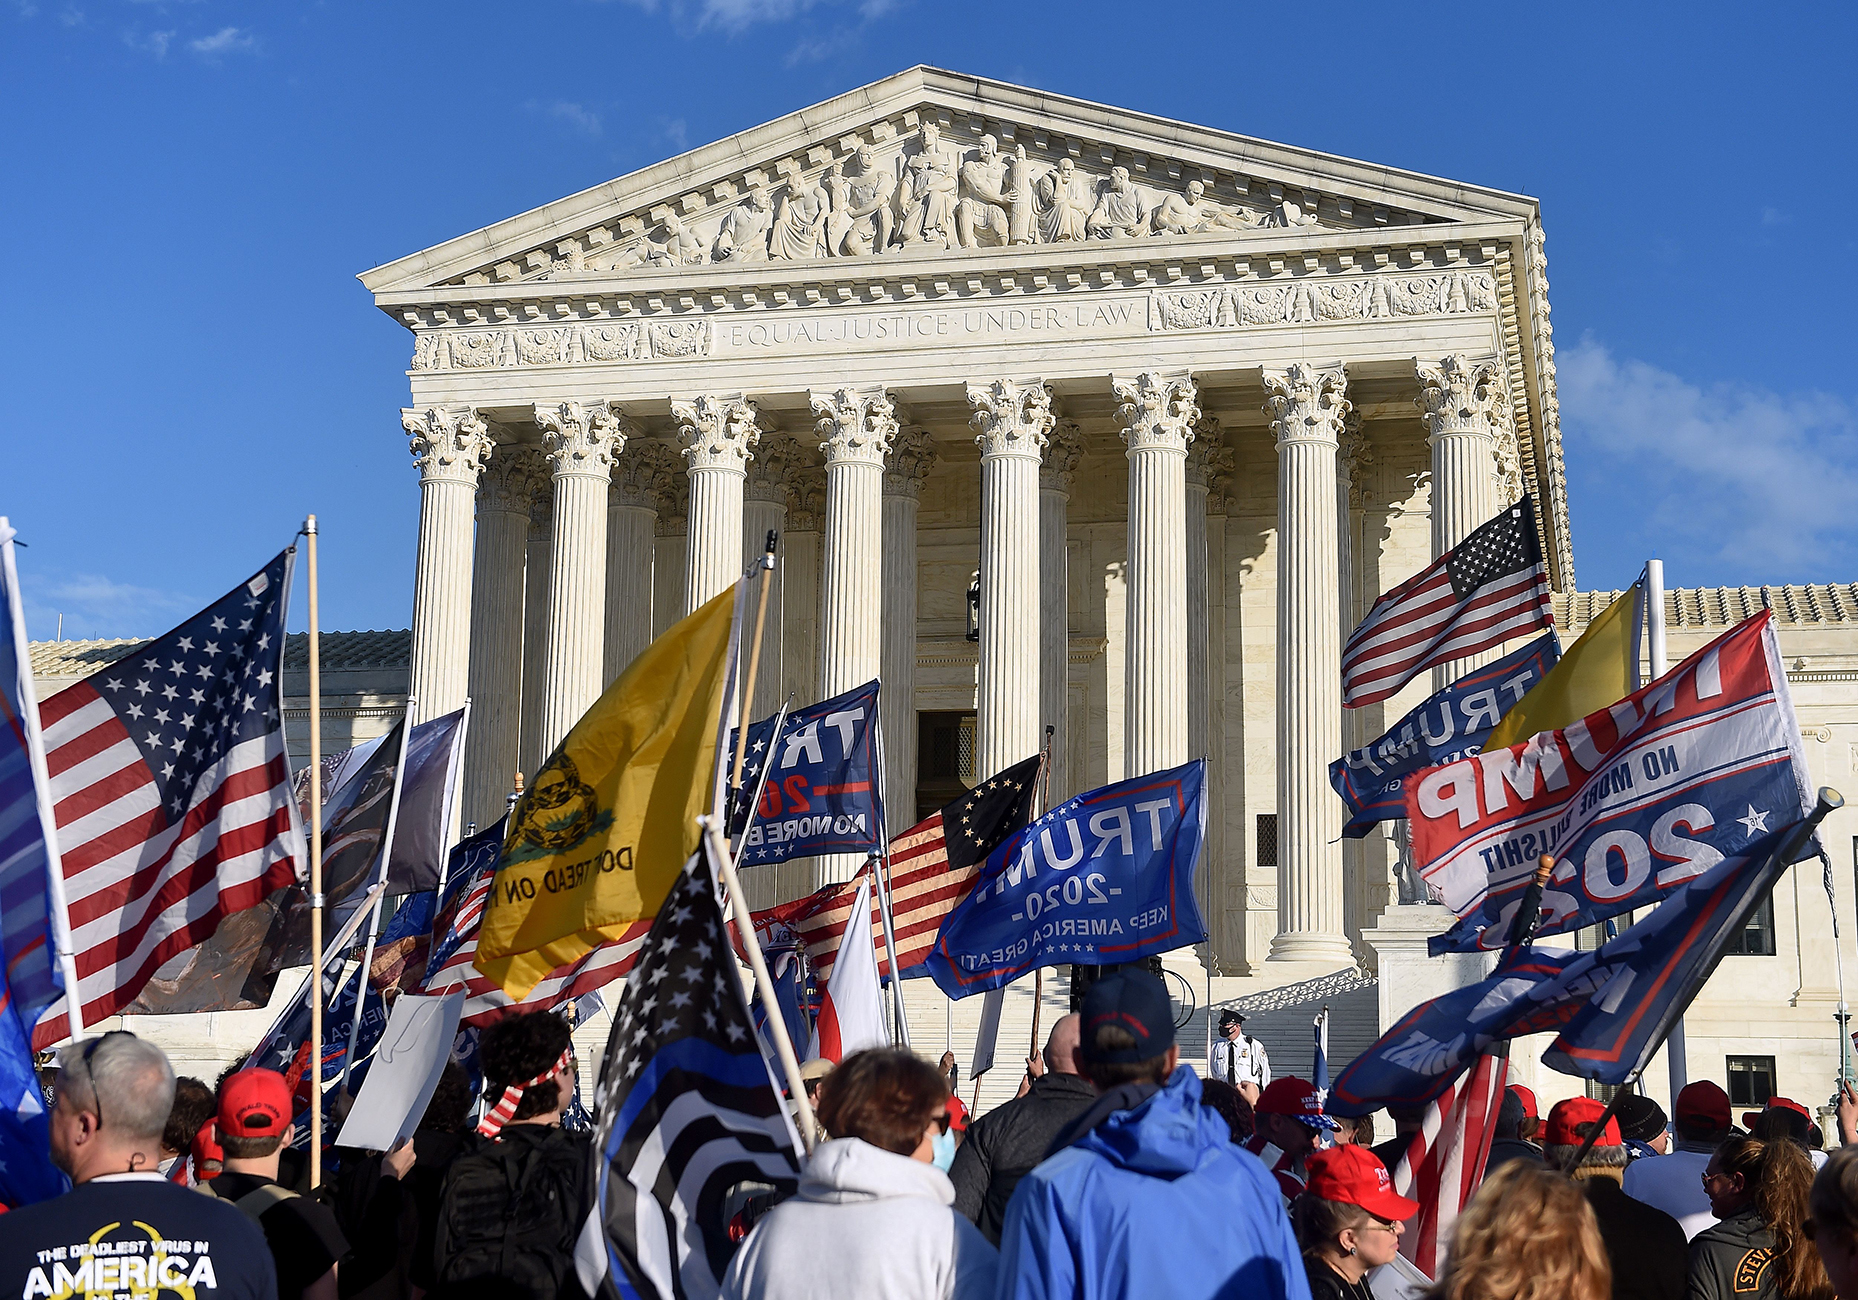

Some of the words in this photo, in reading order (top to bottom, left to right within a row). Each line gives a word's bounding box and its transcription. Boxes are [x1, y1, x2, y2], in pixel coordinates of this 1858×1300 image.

[730, 321, 827, 347] EQUAL
[834, 314, 949, 341] JUSTICE
[963, 308, 1065, 333] UNDER
[1075, 303, 1134, 327] LAW
[36, 1247, 68, 1264] THE
[69, 1241, 148, 1257] DEADLIEST
[151, 1240, 192, 1254] VIRUS
[194, 1241, 210, 1254] IN
[22, 1255, 218, 1300] AMERICA
